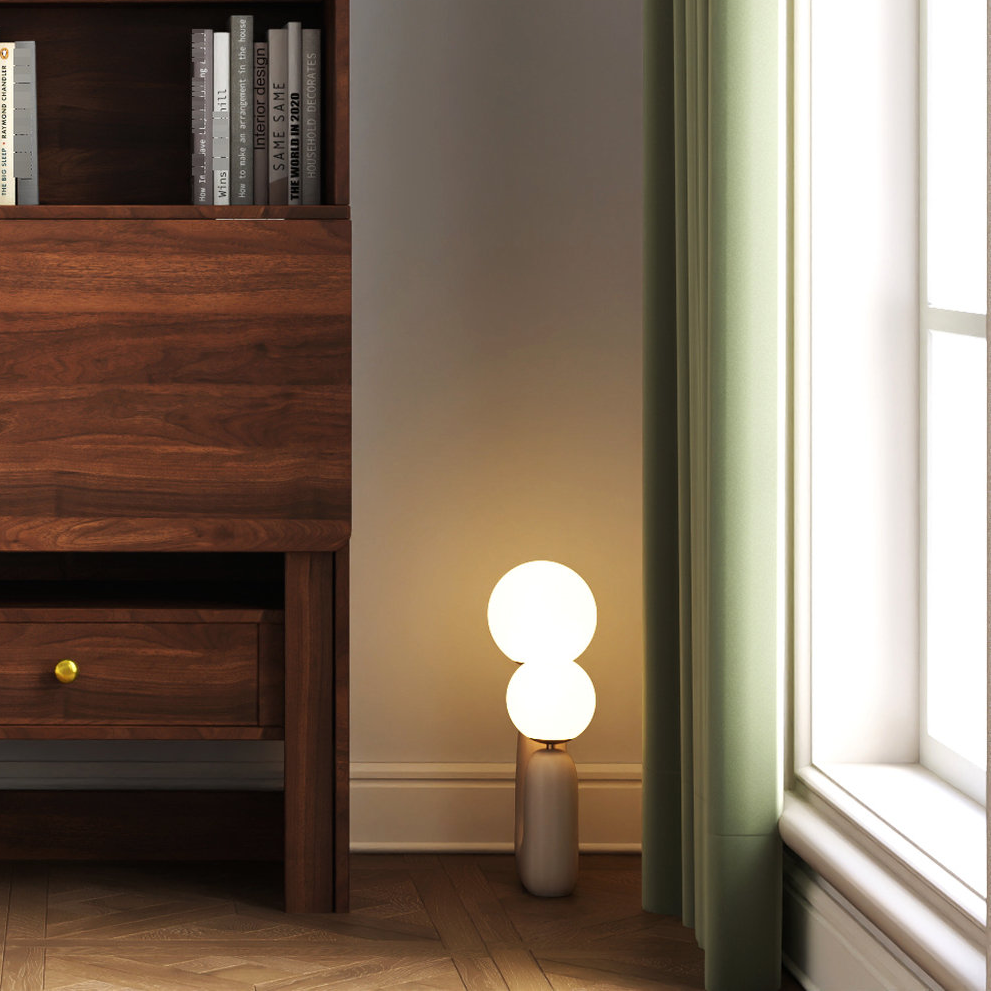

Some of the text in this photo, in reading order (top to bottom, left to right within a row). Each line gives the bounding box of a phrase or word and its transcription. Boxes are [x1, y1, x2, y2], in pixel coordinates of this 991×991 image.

[238, 19, 248, 198] How to make an arrangement in the house
[254, 48, 268, 149] Interior design
[273, 82, 285, 171] SAME SAME
[290, 93, 300, 200] THE WORLD IN 2020
[306, 53, 317, 178] HOUSEHOLD DECORATES
